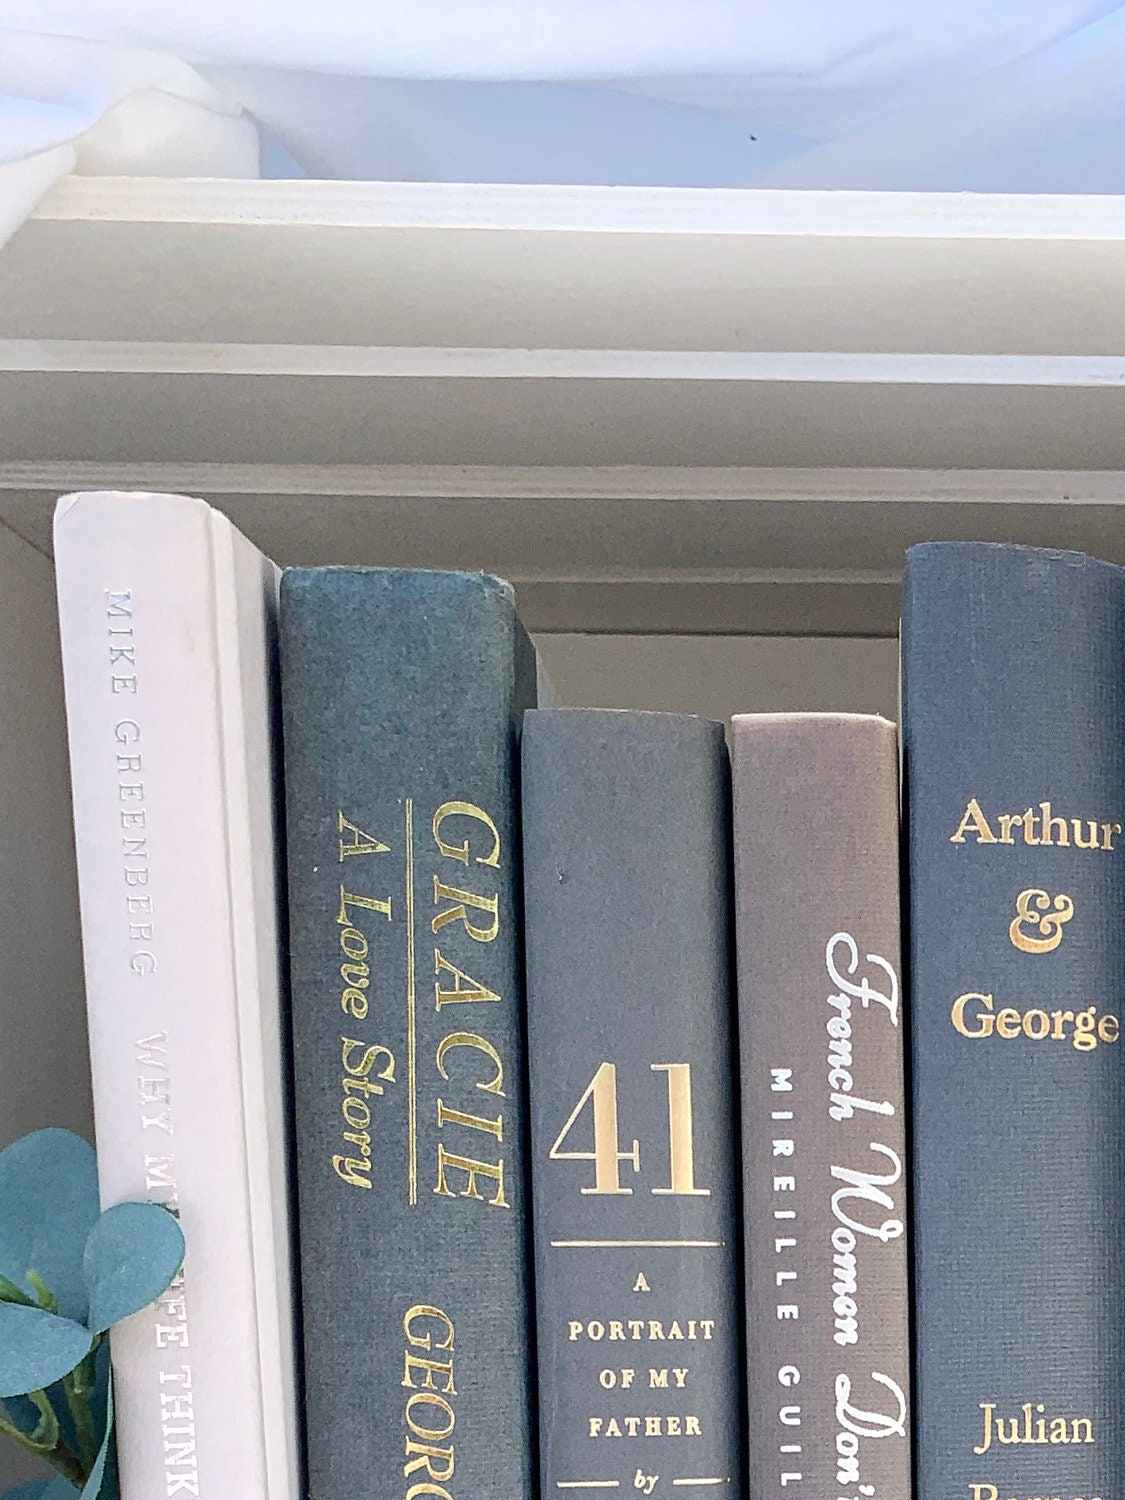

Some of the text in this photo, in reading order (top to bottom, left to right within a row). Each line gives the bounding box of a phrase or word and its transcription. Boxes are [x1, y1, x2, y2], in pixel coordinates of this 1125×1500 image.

[105, 589, 159, 977] MIKE GREENBERG
[949, 799, 1121, 850] Arthur
[1009, 889, 1074, 954] &
[333, 811, 396, 1190] A Love Story
[432, 800, 510, 1208] GRACIE
[826, 932, 898, 1121] French
[951, 993, 1120, 1051] George
[134, 1030, 174, 1135] WHY
[549, 1062, 711, 1195] 41
[770, 1068, 799, 1321] MIREILLE
[831, 1142, 905, 1347] Women
[633, 1272, 650, 1292] A
[569, 1321, 715, 1341] PORTRAIT
[599, 1368, 689, 1389] OF MY
[589, 1417, 702, 1437] FATHER
[974, 1402, 1095, 1454] Julian
[634, 1470, 658, 1494] by
